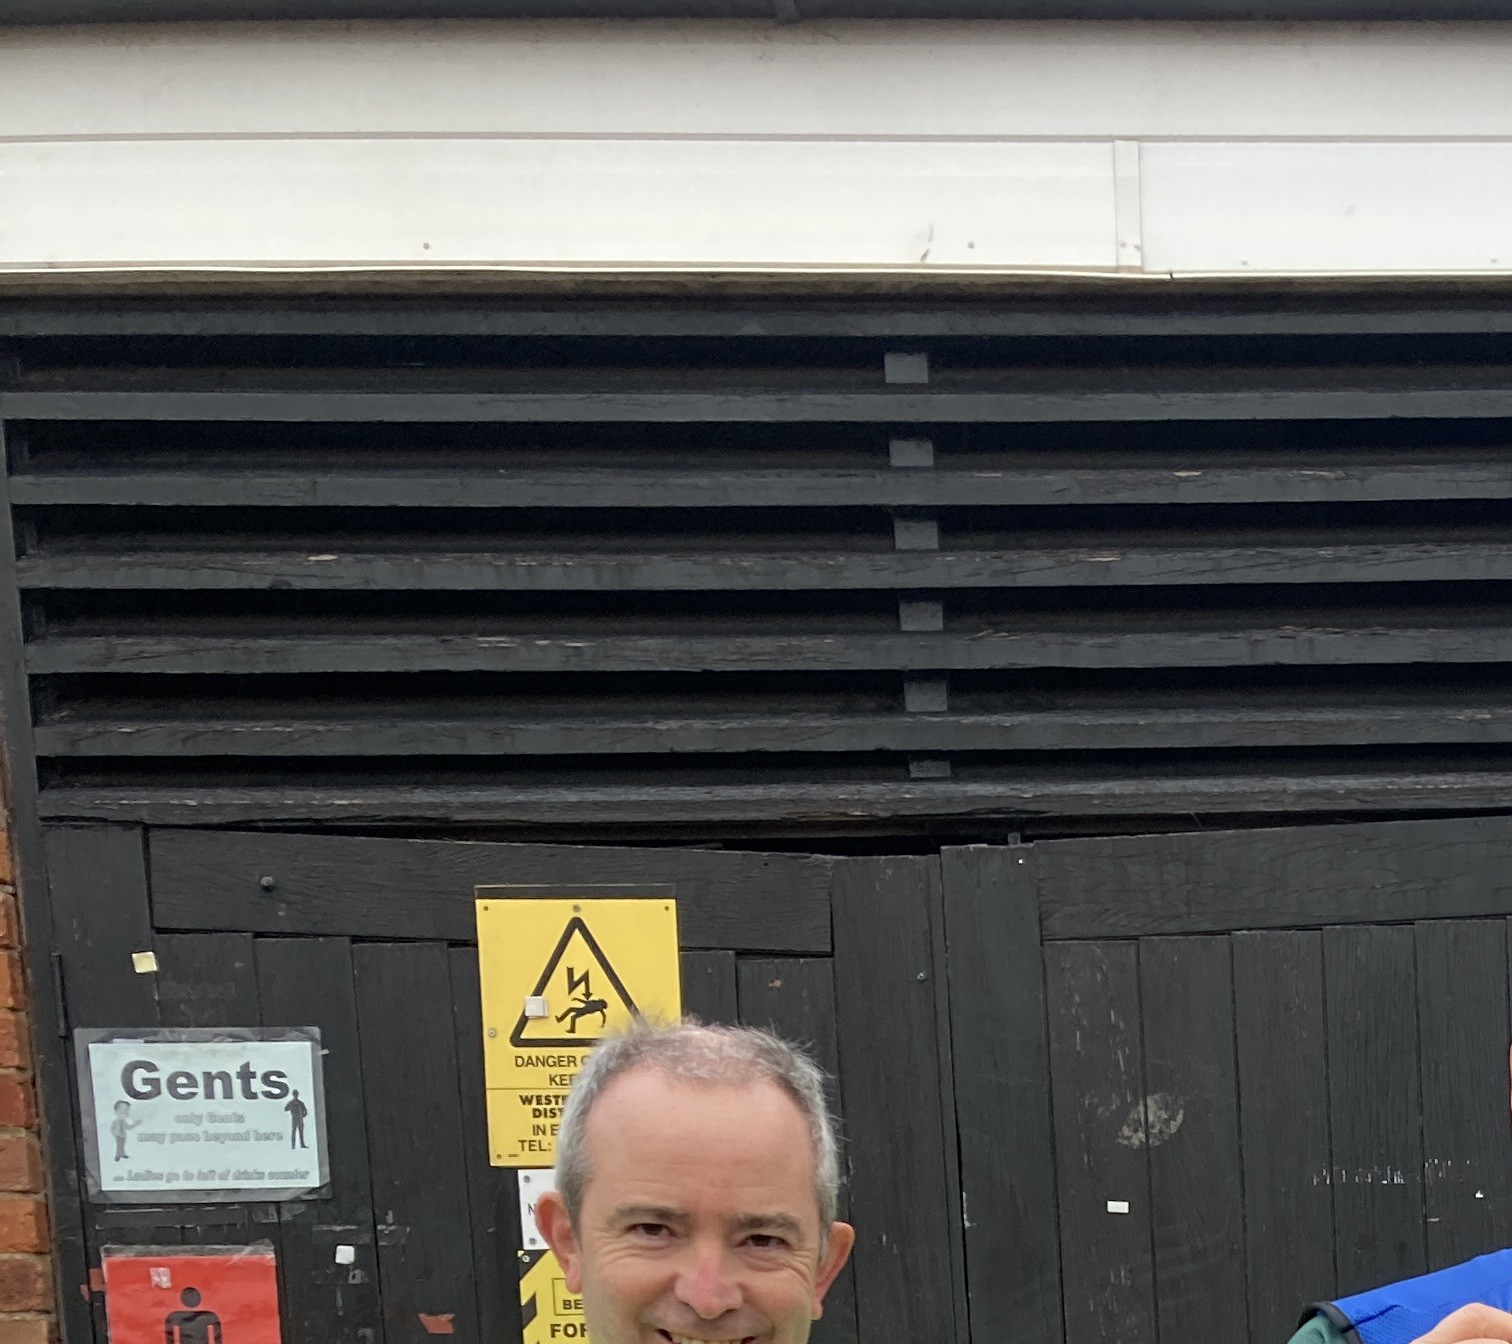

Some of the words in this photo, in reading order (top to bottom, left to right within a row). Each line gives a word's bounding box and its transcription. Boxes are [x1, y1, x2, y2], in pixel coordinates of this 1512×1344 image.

[514, 1055, 577, 1068] DANGER
[120, 1060, 290, 1100] Gents
[532, 1124, 547, 1136] IN
[518, 1139, 552, 1152] TEL:
